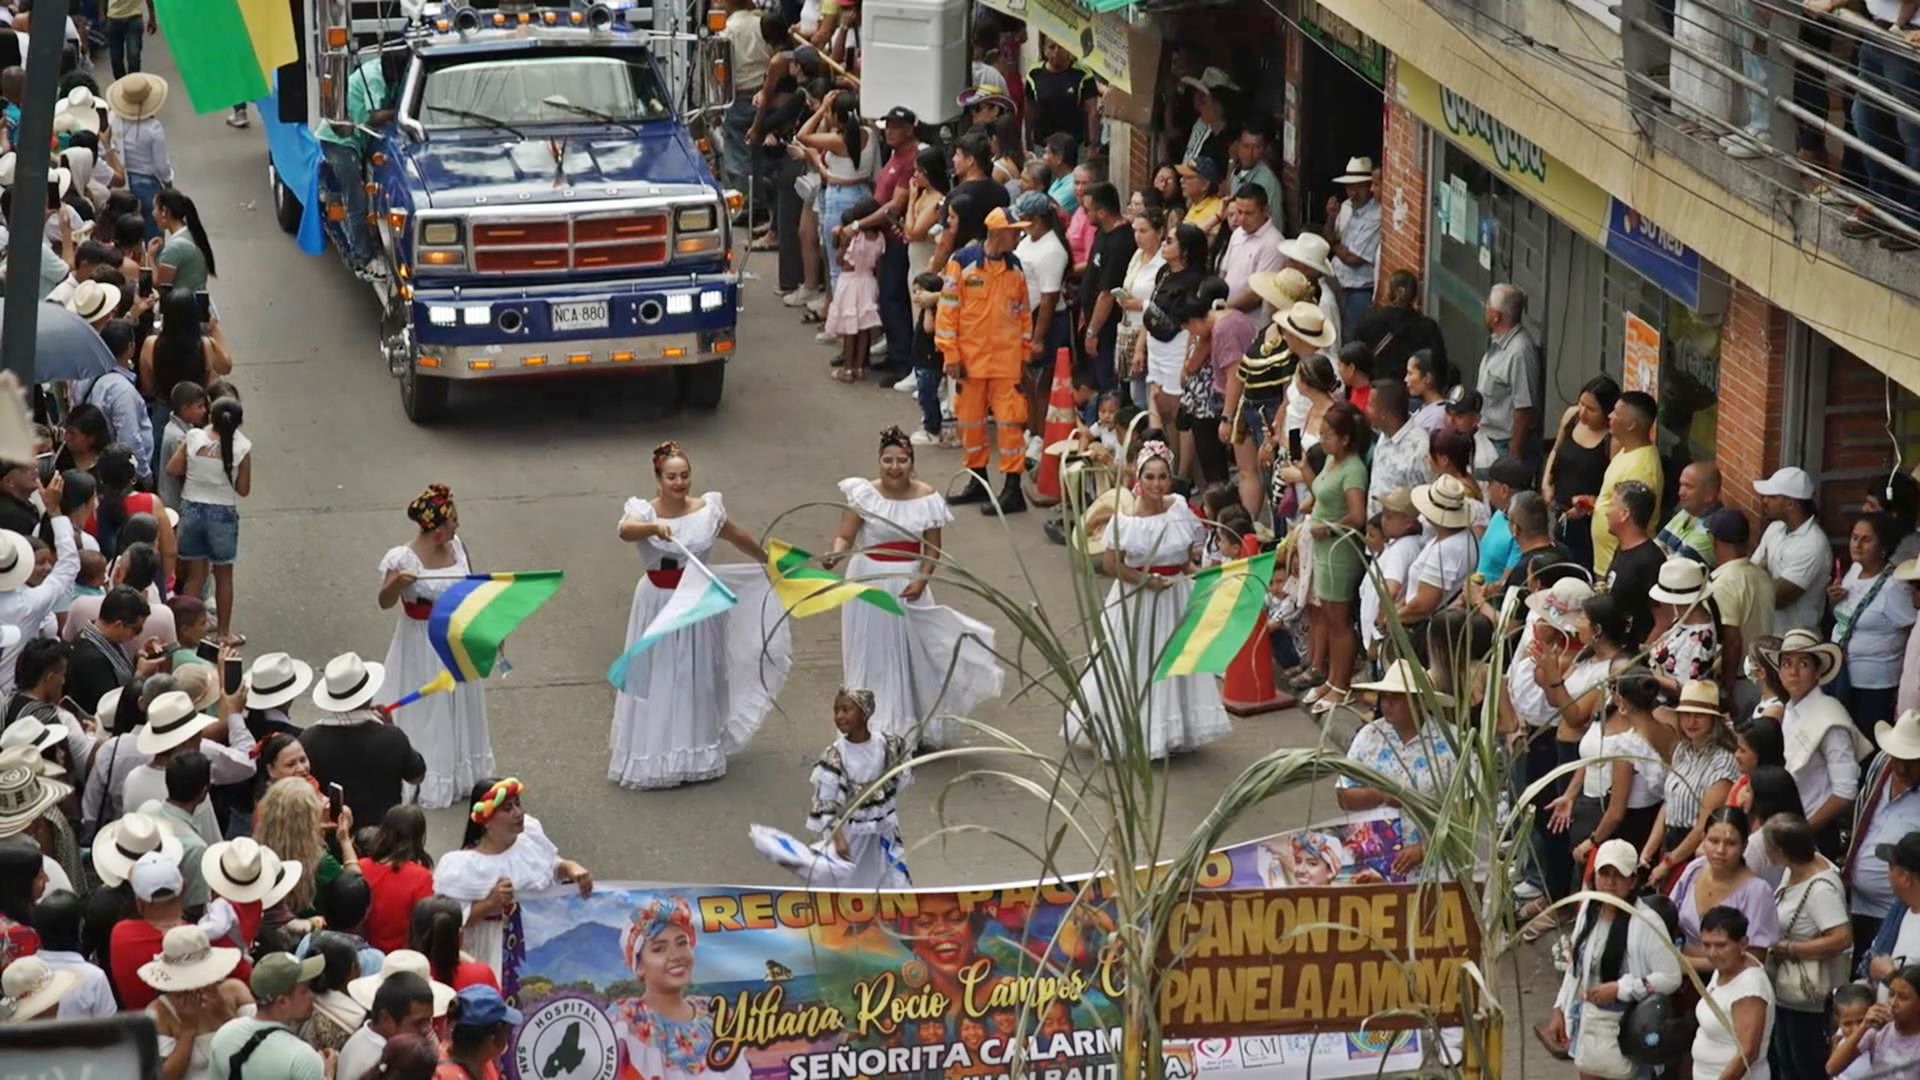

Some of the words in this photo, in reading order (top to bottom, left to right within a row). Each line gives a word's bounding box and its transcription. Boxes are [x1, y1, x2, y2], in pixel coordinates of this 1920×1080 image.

[555, 307, 578, 322] NCA
[582, 304, 605, 321] 880
[698, 891, 920, 933] REGION
[1168, 892, 1330, 957] CAÑON
[1337, 893, 1398, 953] DE
[1407, 890, 1467, 949] LA
[958, 958, 1087, 1021] Campos
[1160, 962, 1323, 1026] PANELA
[535, 1002, 597, 1029] HOSPITAL
[518, 1046, 530, 1074] SAN
[789, 1040, 972, 1080] SEÑORITA
[979, 1026, 1124, 1065] CALARM
[1243, 1036, 1278, 1058] CM
